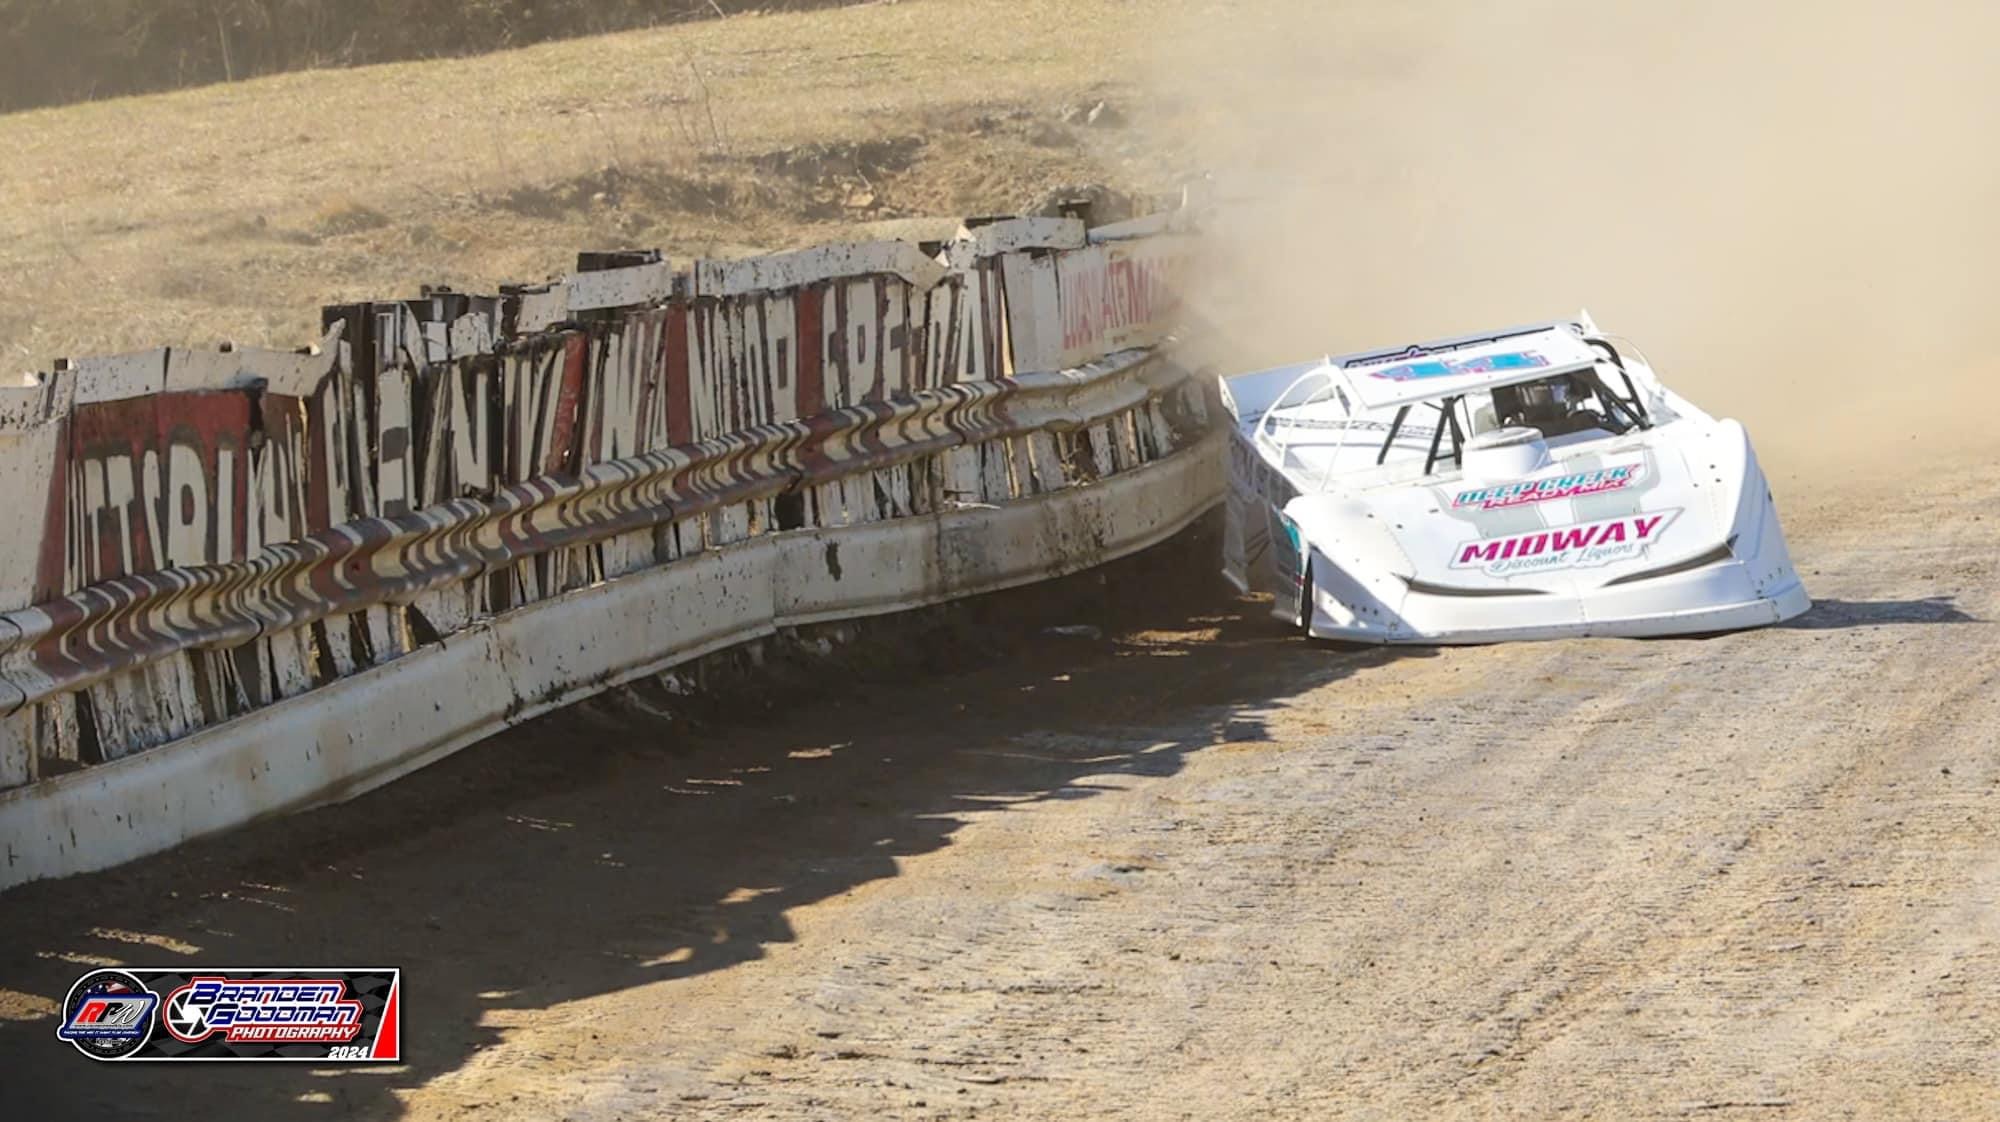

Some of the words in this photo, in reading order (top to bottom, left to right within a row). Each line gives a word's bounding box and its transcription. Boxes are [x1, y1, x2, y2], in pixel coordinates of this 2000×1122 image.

[1459, 514, 1664, 563] MIDWAY
[1492, 552, 1565, 572] Discount
[1577, 543, 1634, 563] Liquors
